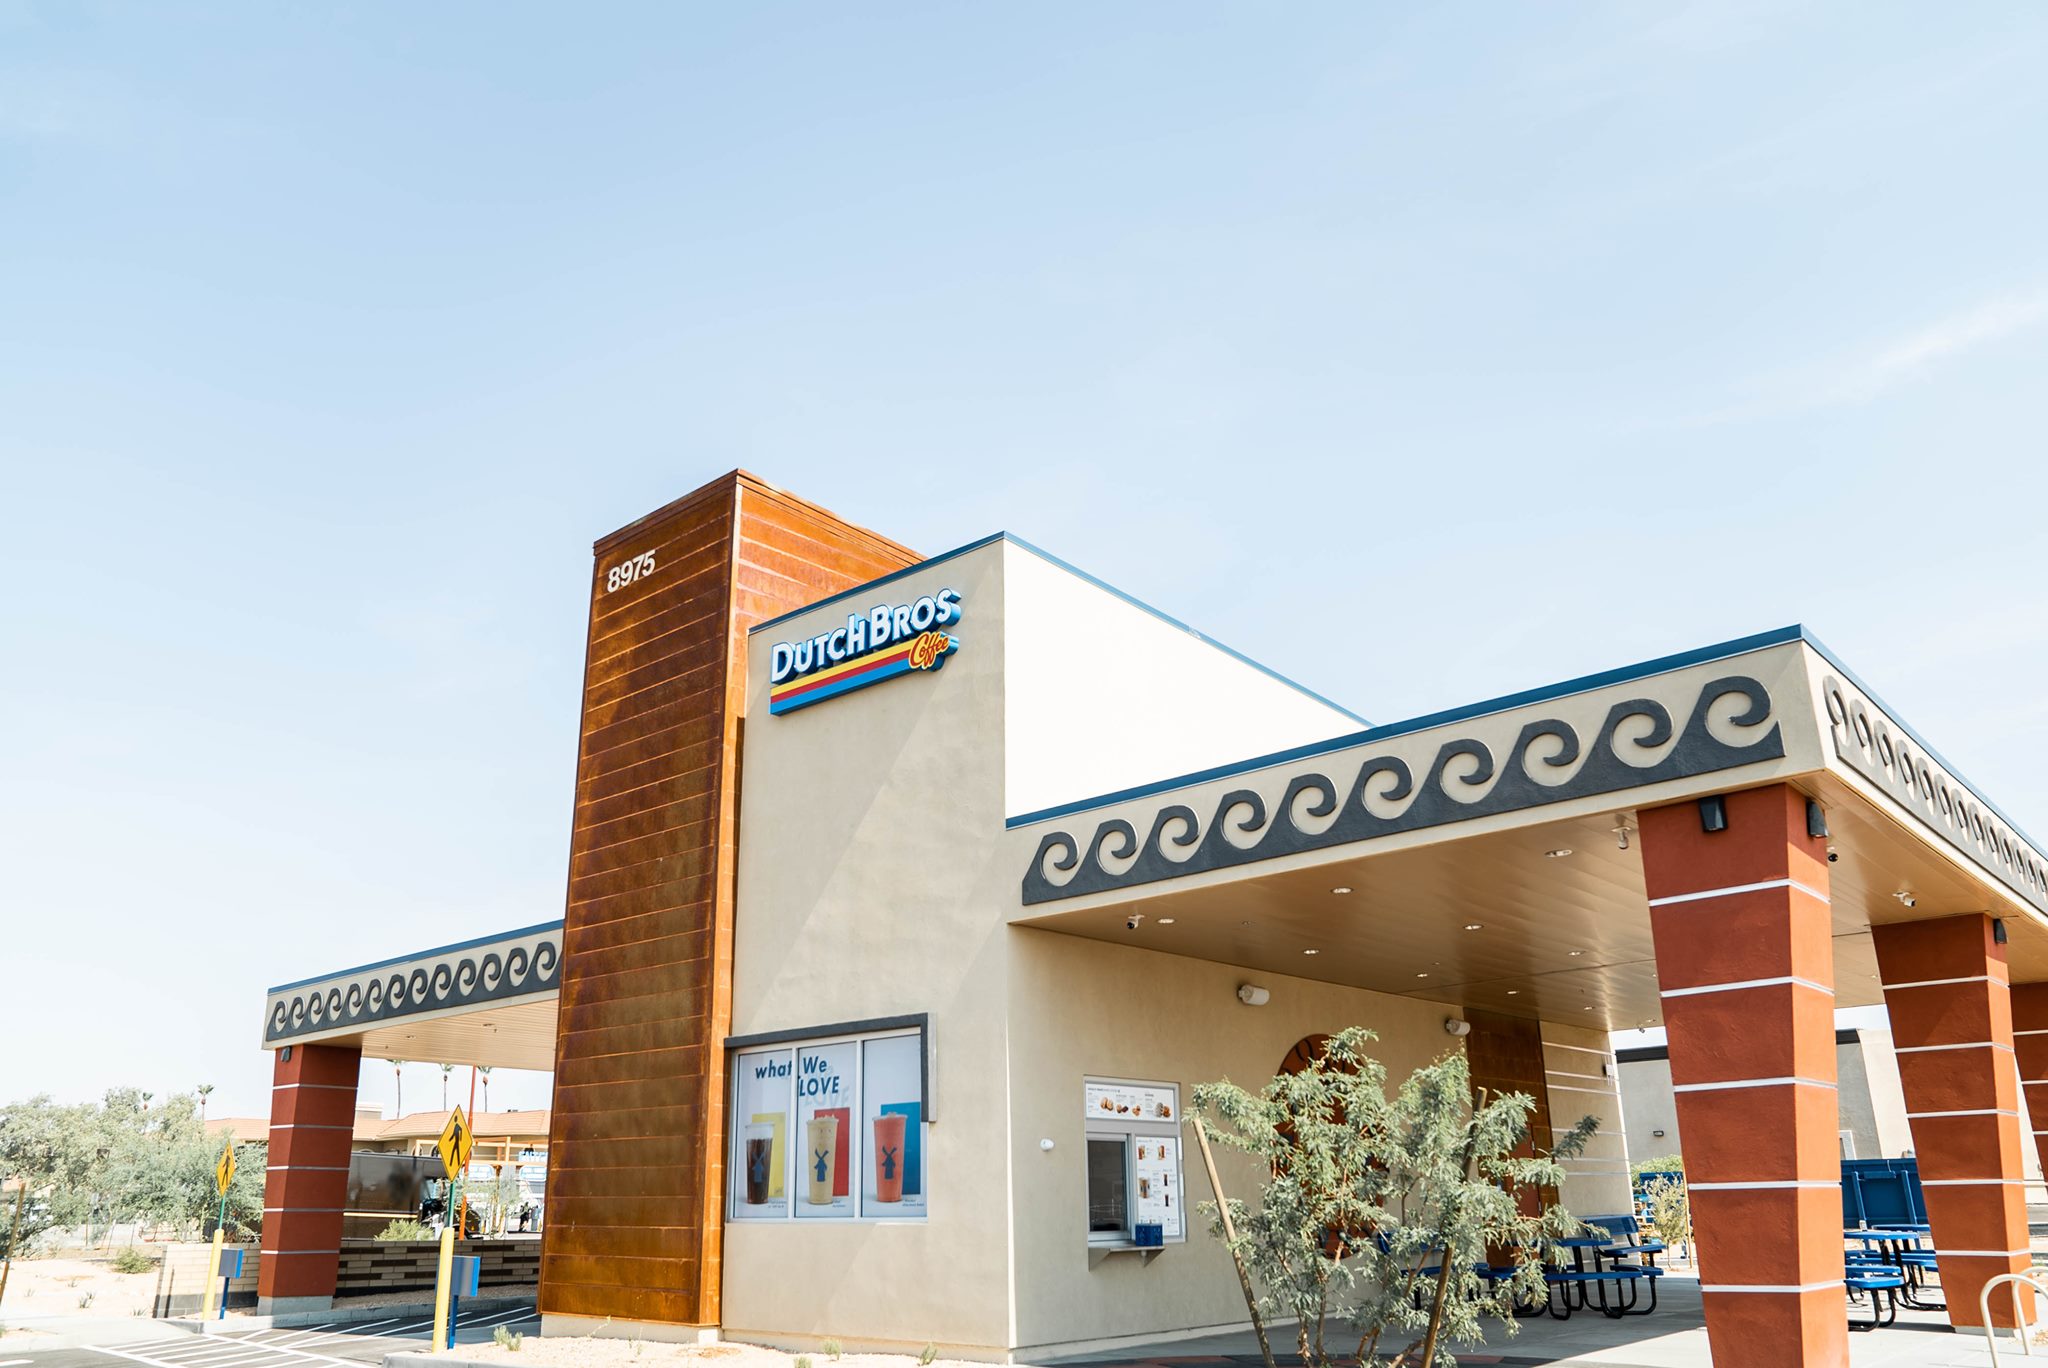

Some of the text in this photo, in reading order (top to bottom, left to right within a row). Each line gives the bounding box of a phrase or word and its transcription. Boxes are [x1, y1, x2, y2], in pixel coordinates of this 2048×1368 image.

[607, 549, 656, 593] 8975
[770, 588, 962, 684] DUTCH BROS
[908, 631, 952, 669] Coffee
[803, 1056, 828, 1074] We
[799, 1076, 840, 1097] LOVE
